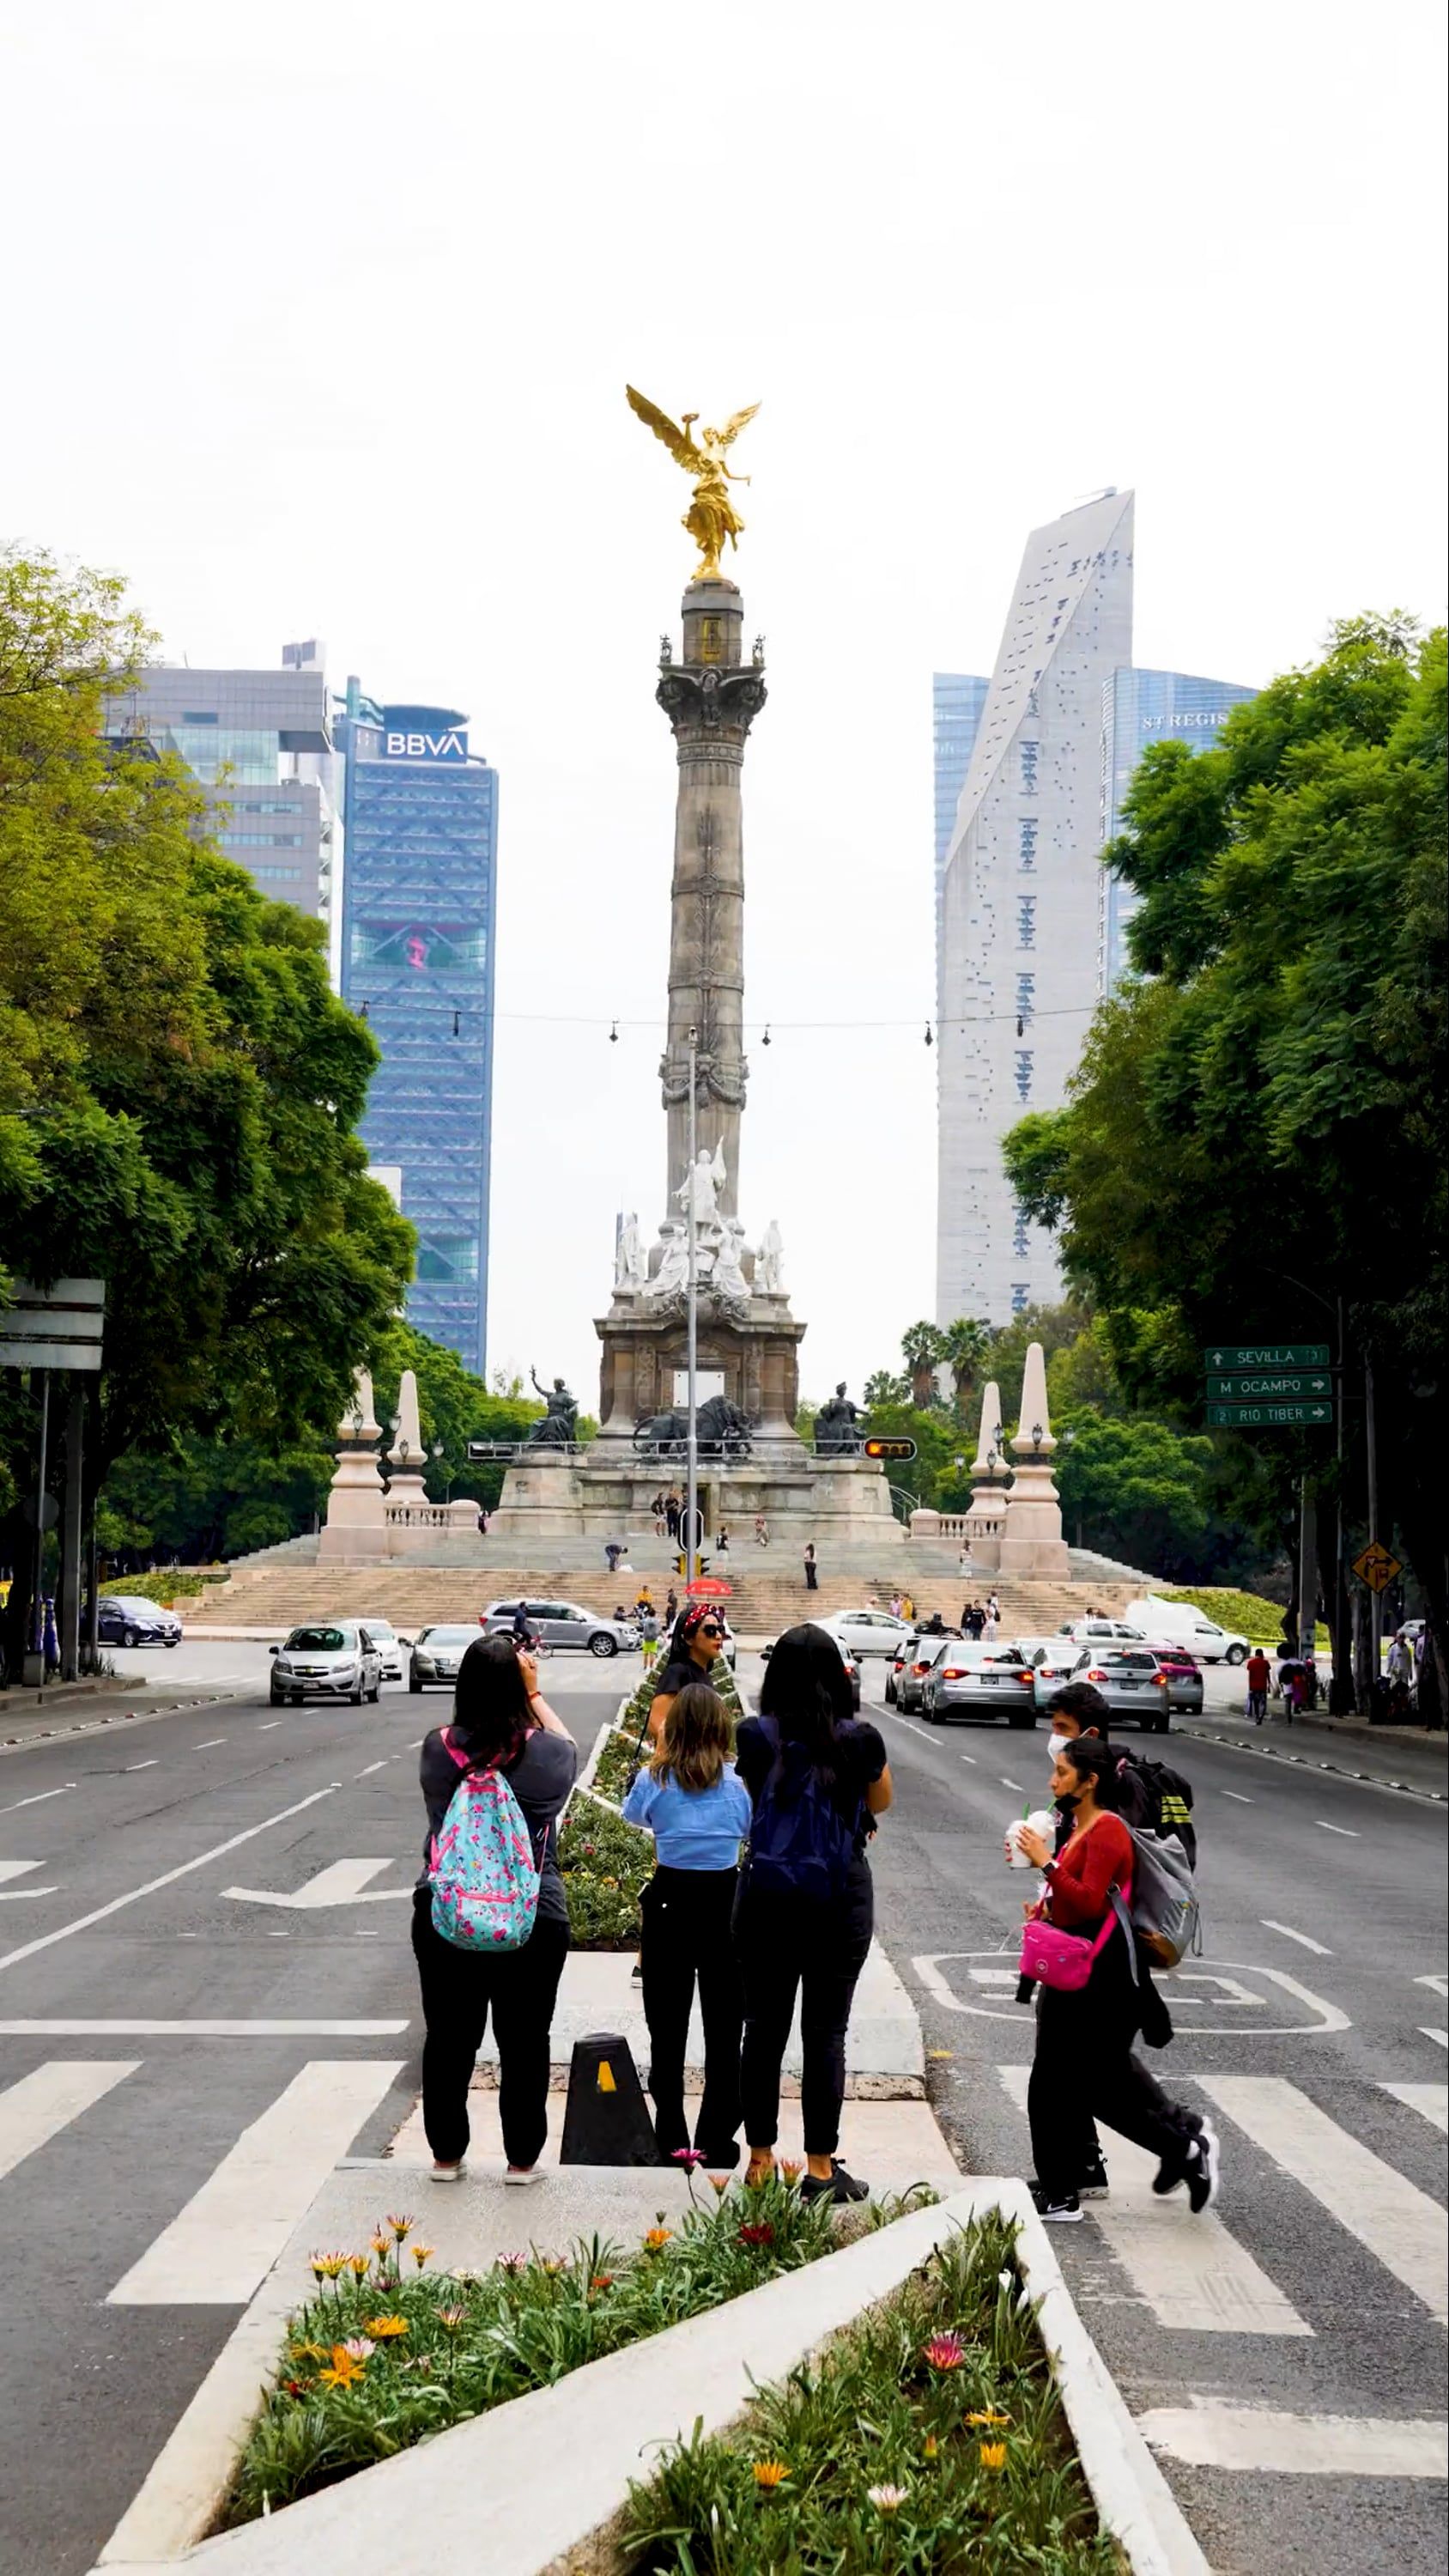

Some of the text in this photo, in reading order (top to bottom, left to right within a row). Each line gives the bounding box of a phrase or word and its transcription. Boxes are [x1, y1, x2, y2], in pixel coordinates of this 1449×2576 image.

[1170, 714, 1228, 727] REGIS
[387, 732, 464, 756] BBVA
[1237, 1350, 1294, 1364] SEVILLA
[1221, 1380, 1300, 1393] M OCAMPO
[1219, 1408, 1304, 1422] 2 RIO TIBER
